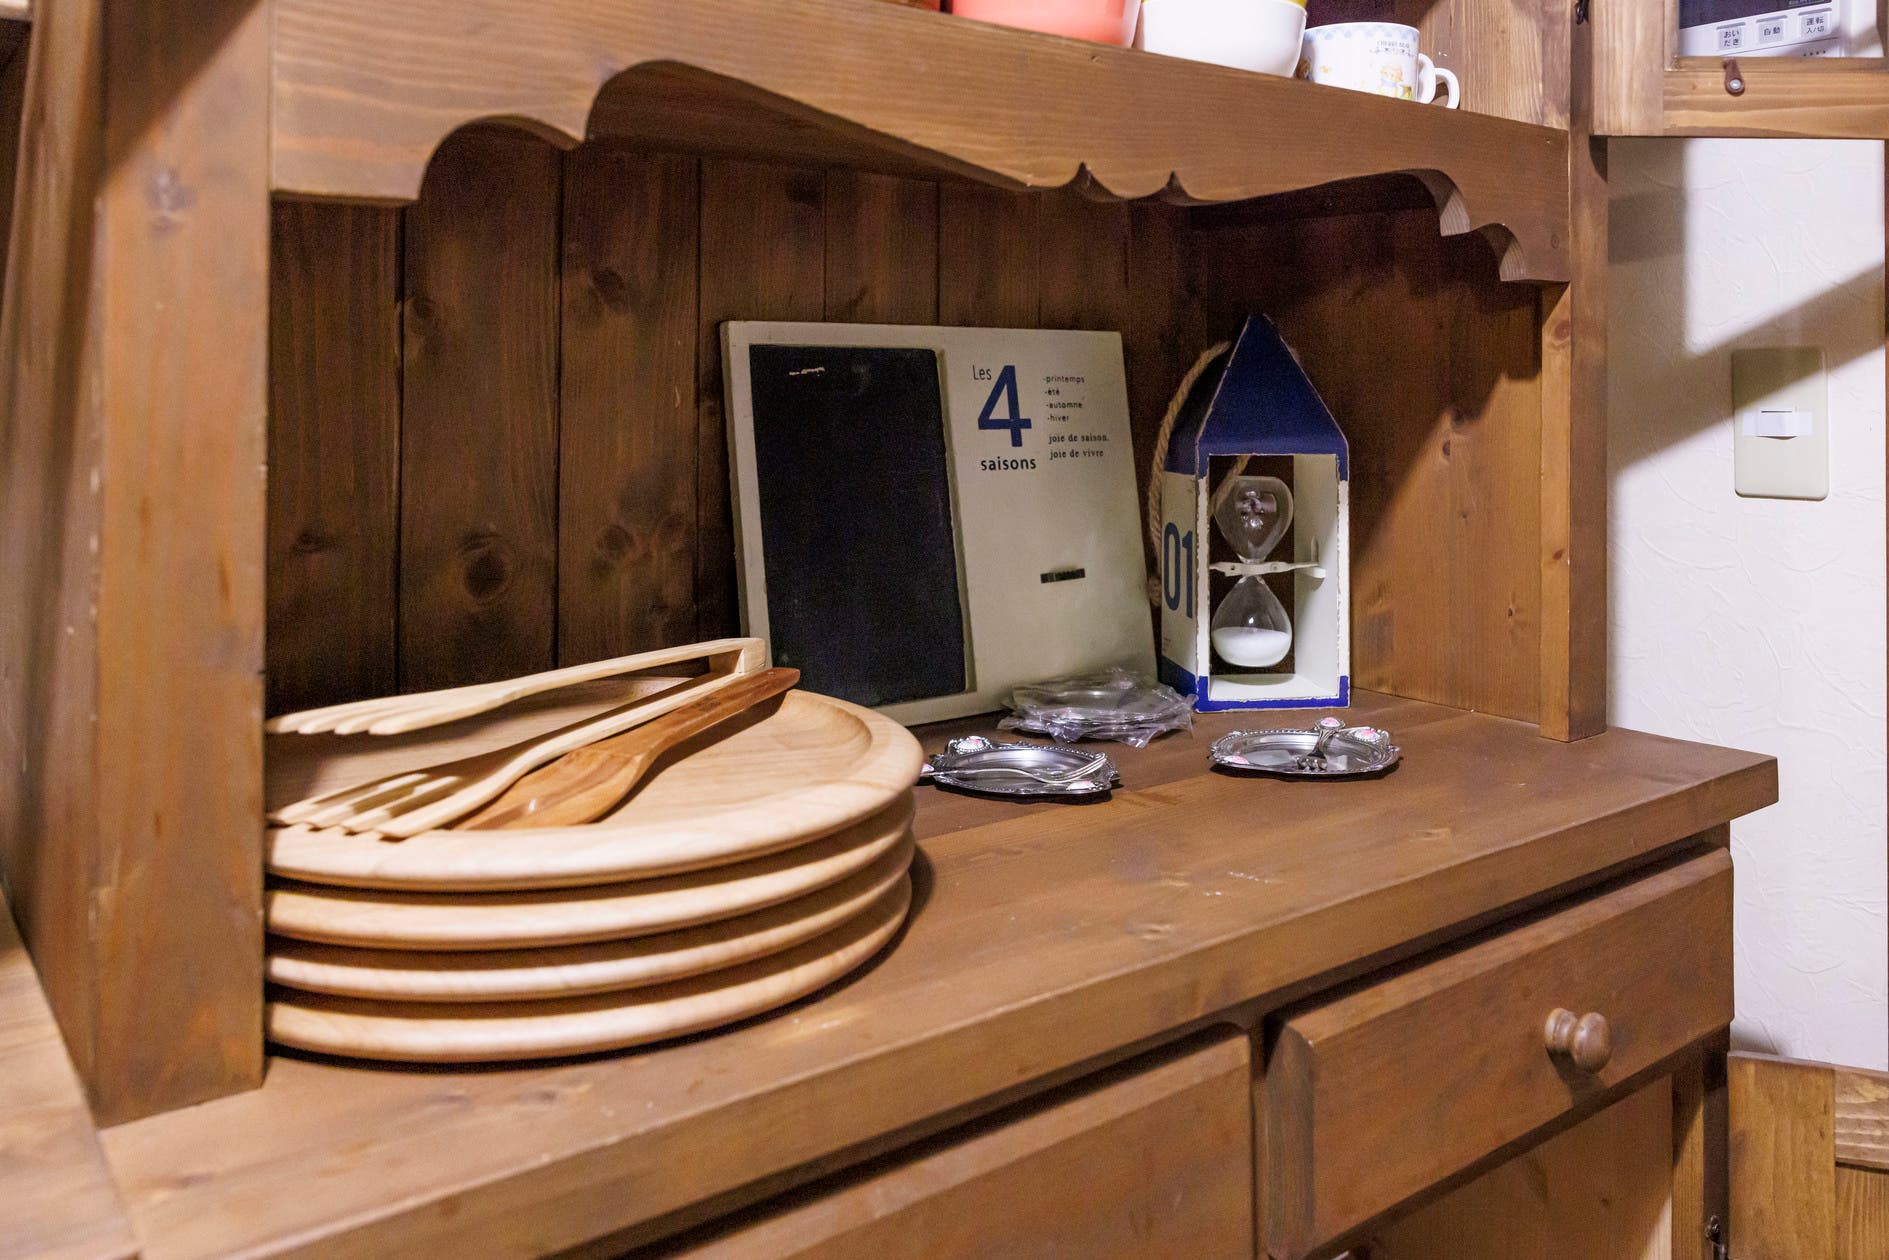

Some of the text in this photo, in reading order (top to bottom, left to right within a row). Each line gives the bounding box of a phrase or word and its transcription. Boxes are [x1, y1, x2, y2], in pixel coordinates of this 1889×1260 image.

[1806, 16, 1824, 26] 運転
[1723, 29, 1740, 38] おい
[1763, 26, 1781, 36] 自動
[1806, 25, 1825, 34] 入/切
[1723, 38, 1740, 47] だき
[972, 364, 1032, 448] Les 4
[1048, 432, 1110, 445] joie de saison.
[1049, 448, 1104, 461] joie de vivre
[980, 456, 1037, 471] saisons
[1164, 522, 1193, 619] 01
